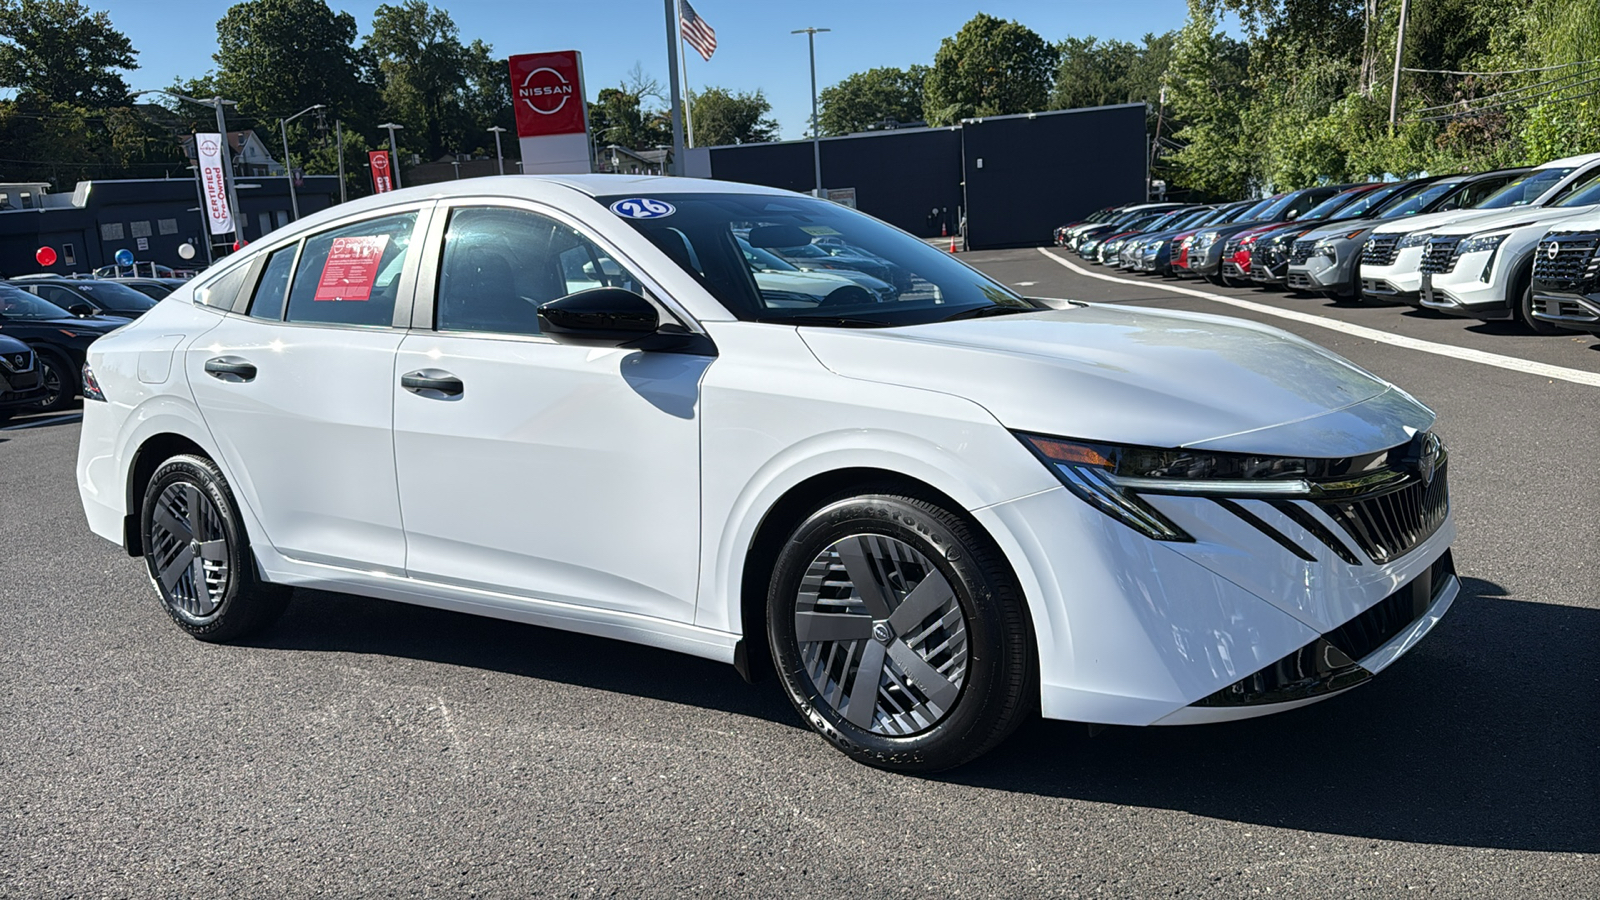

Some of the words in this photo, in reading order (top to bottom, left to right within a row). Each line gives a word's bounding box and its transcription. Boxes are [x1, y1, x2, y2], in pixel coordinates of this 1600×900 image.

[519, 85, 572, 97] NISSAN
[204, 167, 221, 219] CERTIFIED
[213, 167, 228, 219] Pre-Owned
[622, 198, 667, 218] 26
